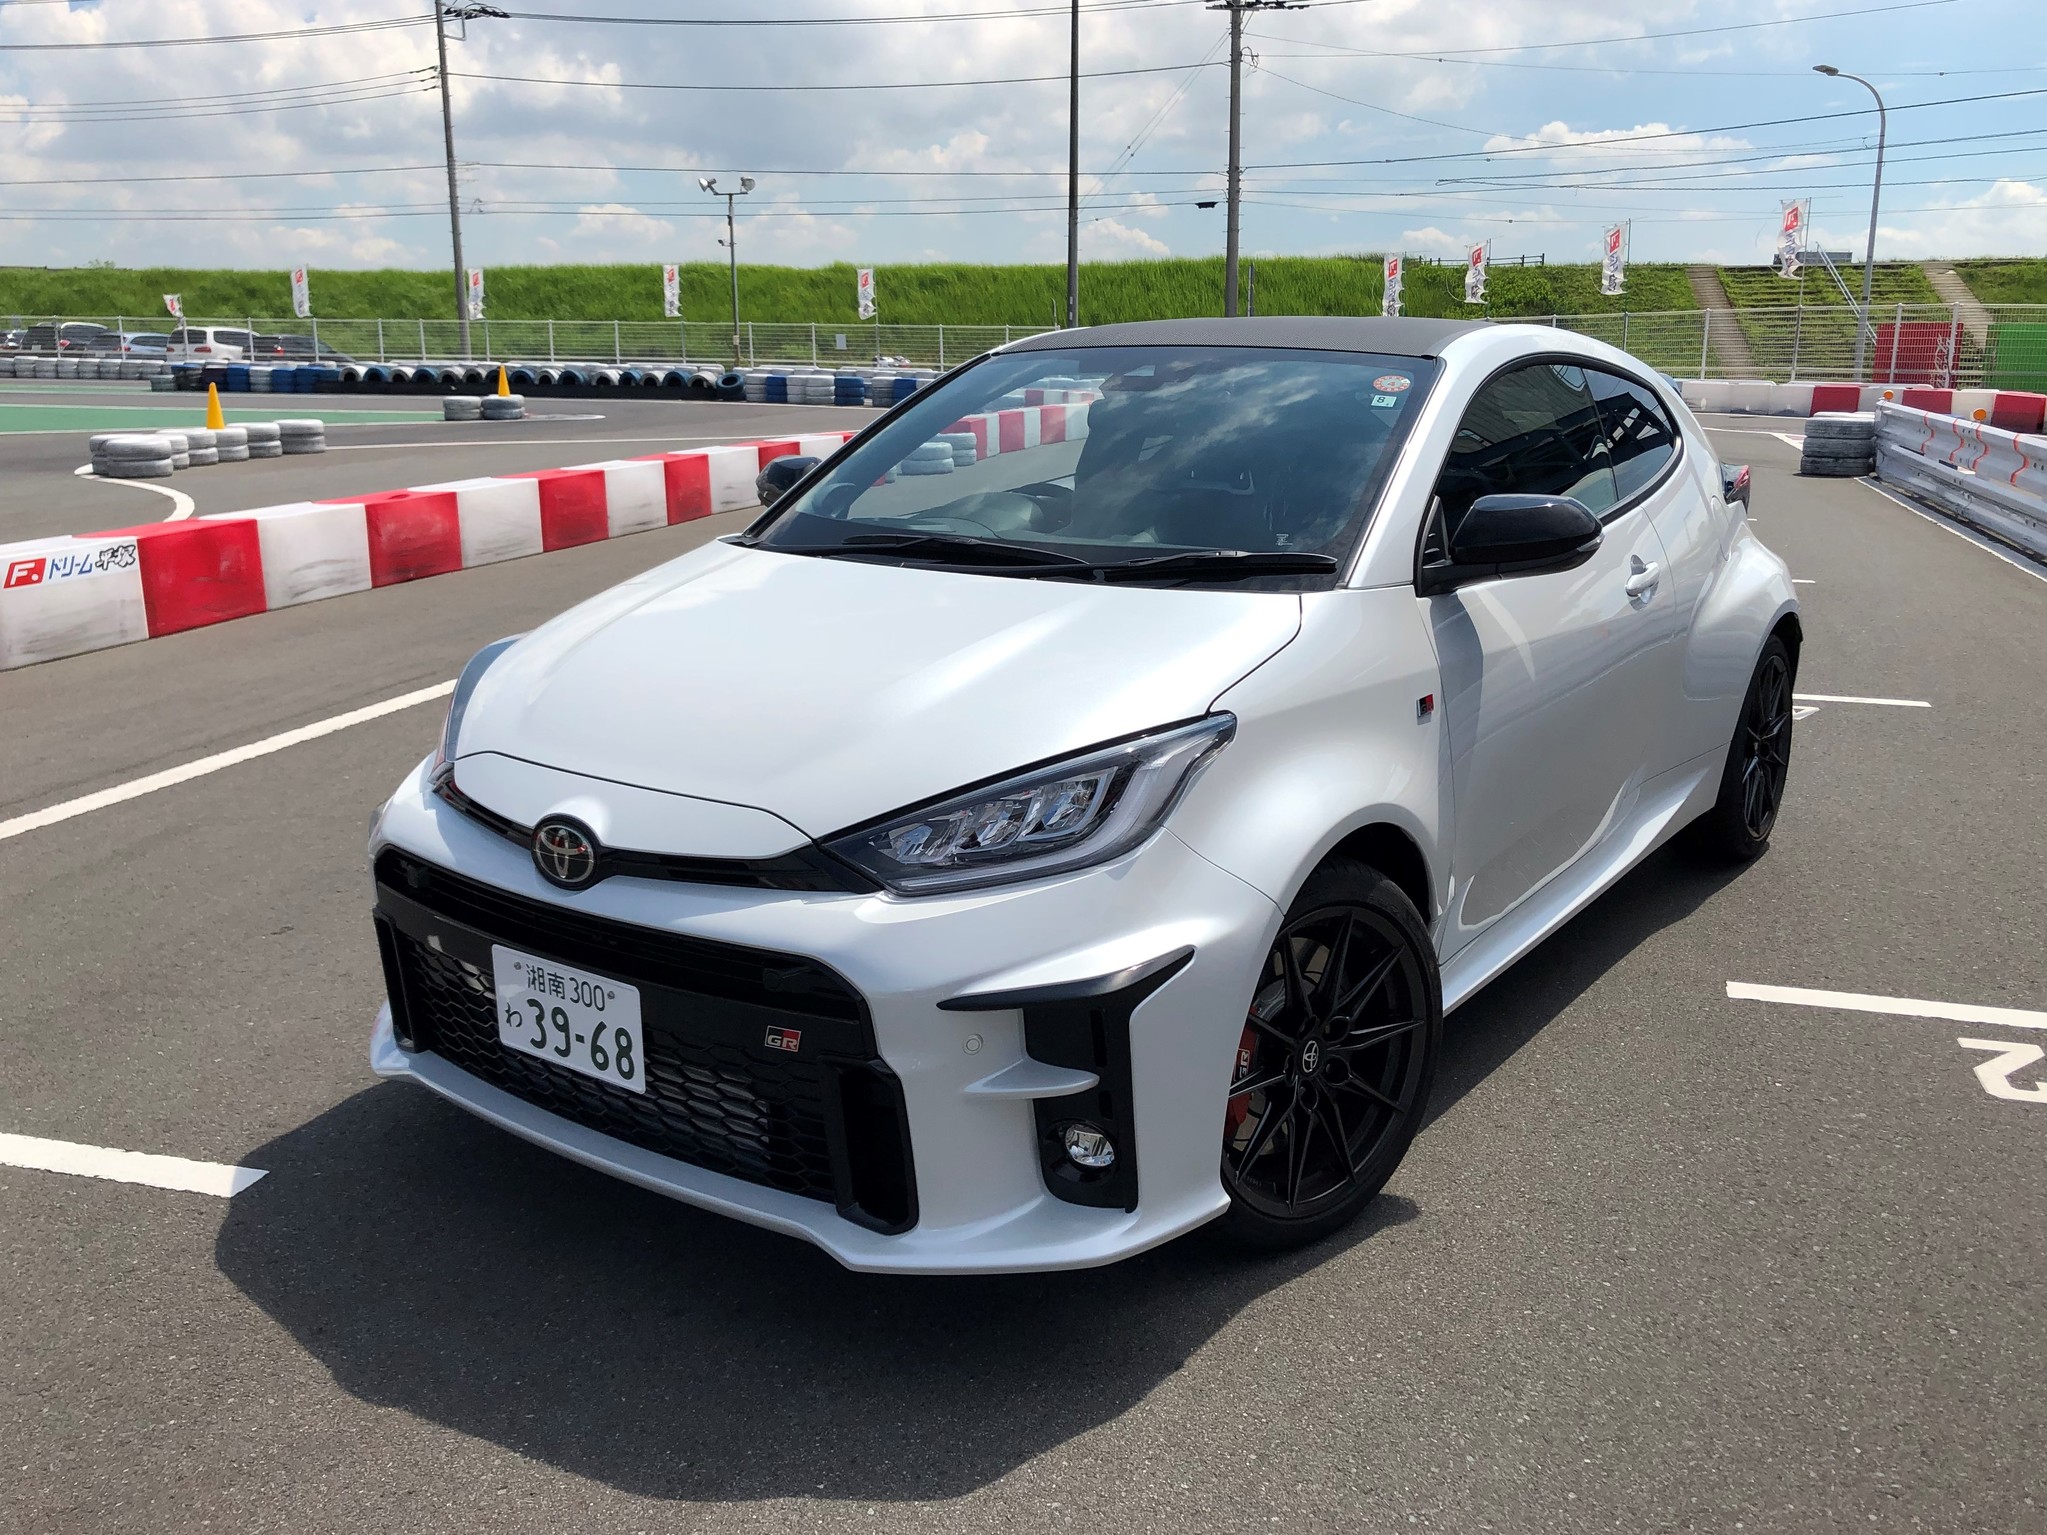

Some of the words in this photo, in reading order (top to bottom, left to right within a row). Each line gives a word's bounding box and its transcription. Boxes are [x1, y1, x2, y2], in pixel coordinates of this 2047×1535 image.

[525, 962, 606, 1012] 湘南300
[504, 1001, 523, 1028] わ
[526, 998, 636, 1081] 39-68
[767, 1034, 798, 1050] GR
